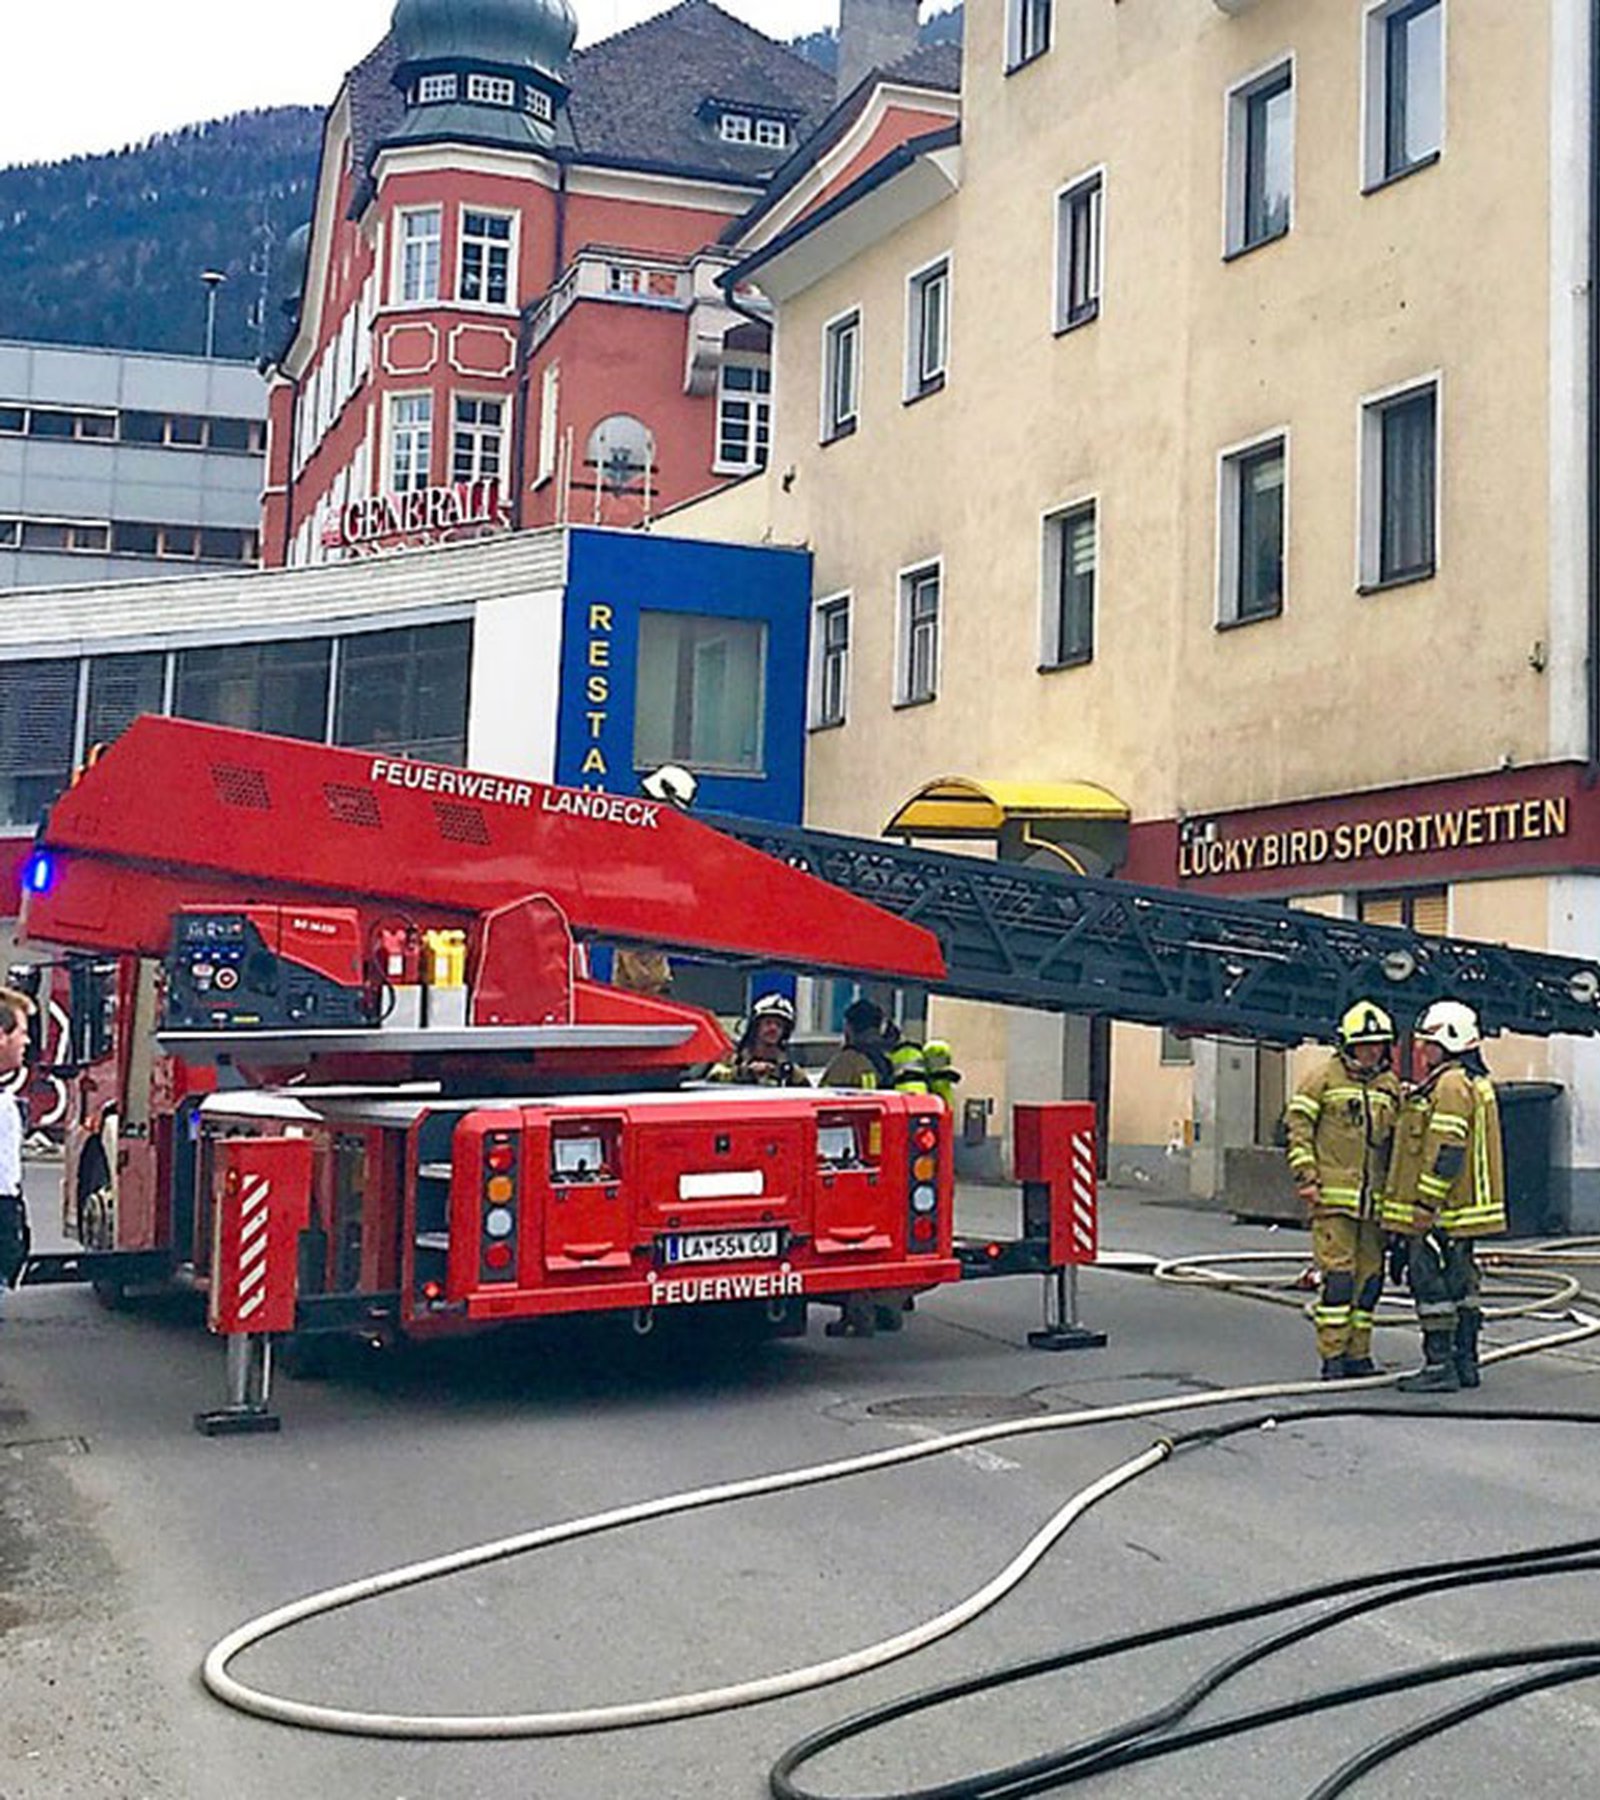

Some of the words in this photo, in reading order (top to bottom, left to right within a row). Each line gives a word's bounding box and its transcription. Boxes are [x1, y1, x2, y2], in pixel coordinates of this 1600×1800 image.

[343, 479, 493, 541] GENERALI
[581, 603, 613, 793] RESTA
[370, 759, 533, 808] FEUERWEHR
[541, 789, 661, 829] LANDECK
[1178, 836, 1258, 877] LUCKY
[1263, 828, 1328, 866] BIRD
[1333, 797, 1567, 860] SPORTWETTEN
[651, 1272, 803, 1305] FEUERWEHR
